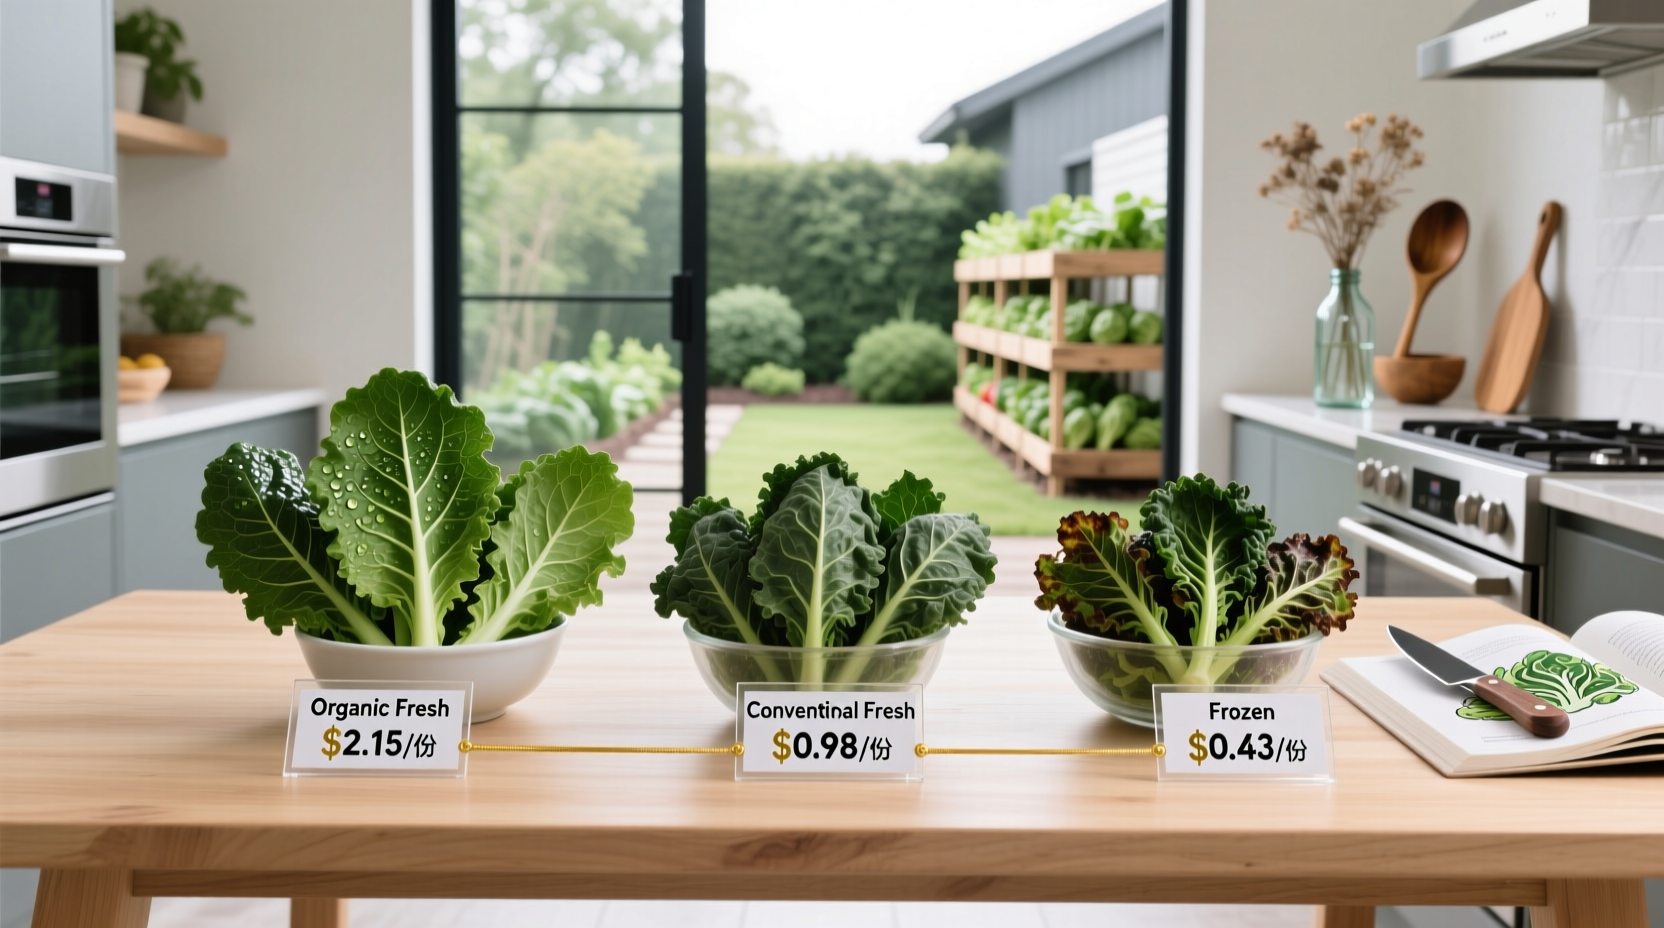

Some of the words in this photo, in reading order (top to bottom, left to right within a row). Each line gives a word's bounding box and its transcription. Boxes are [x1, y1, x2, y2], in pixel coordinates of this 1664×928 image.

[310, 697, 390, 721] Organic
[395, 698, 450, 717] Fresh
[864, 701, 915, 719] Fresh
[1209, 702, 1275, 720] Frozen
[321, 724, 437, 761] $2.15/份
[772, 728, 892, 765] $0.98/份
[1188, 729, 1307, 766] $0.43/份
